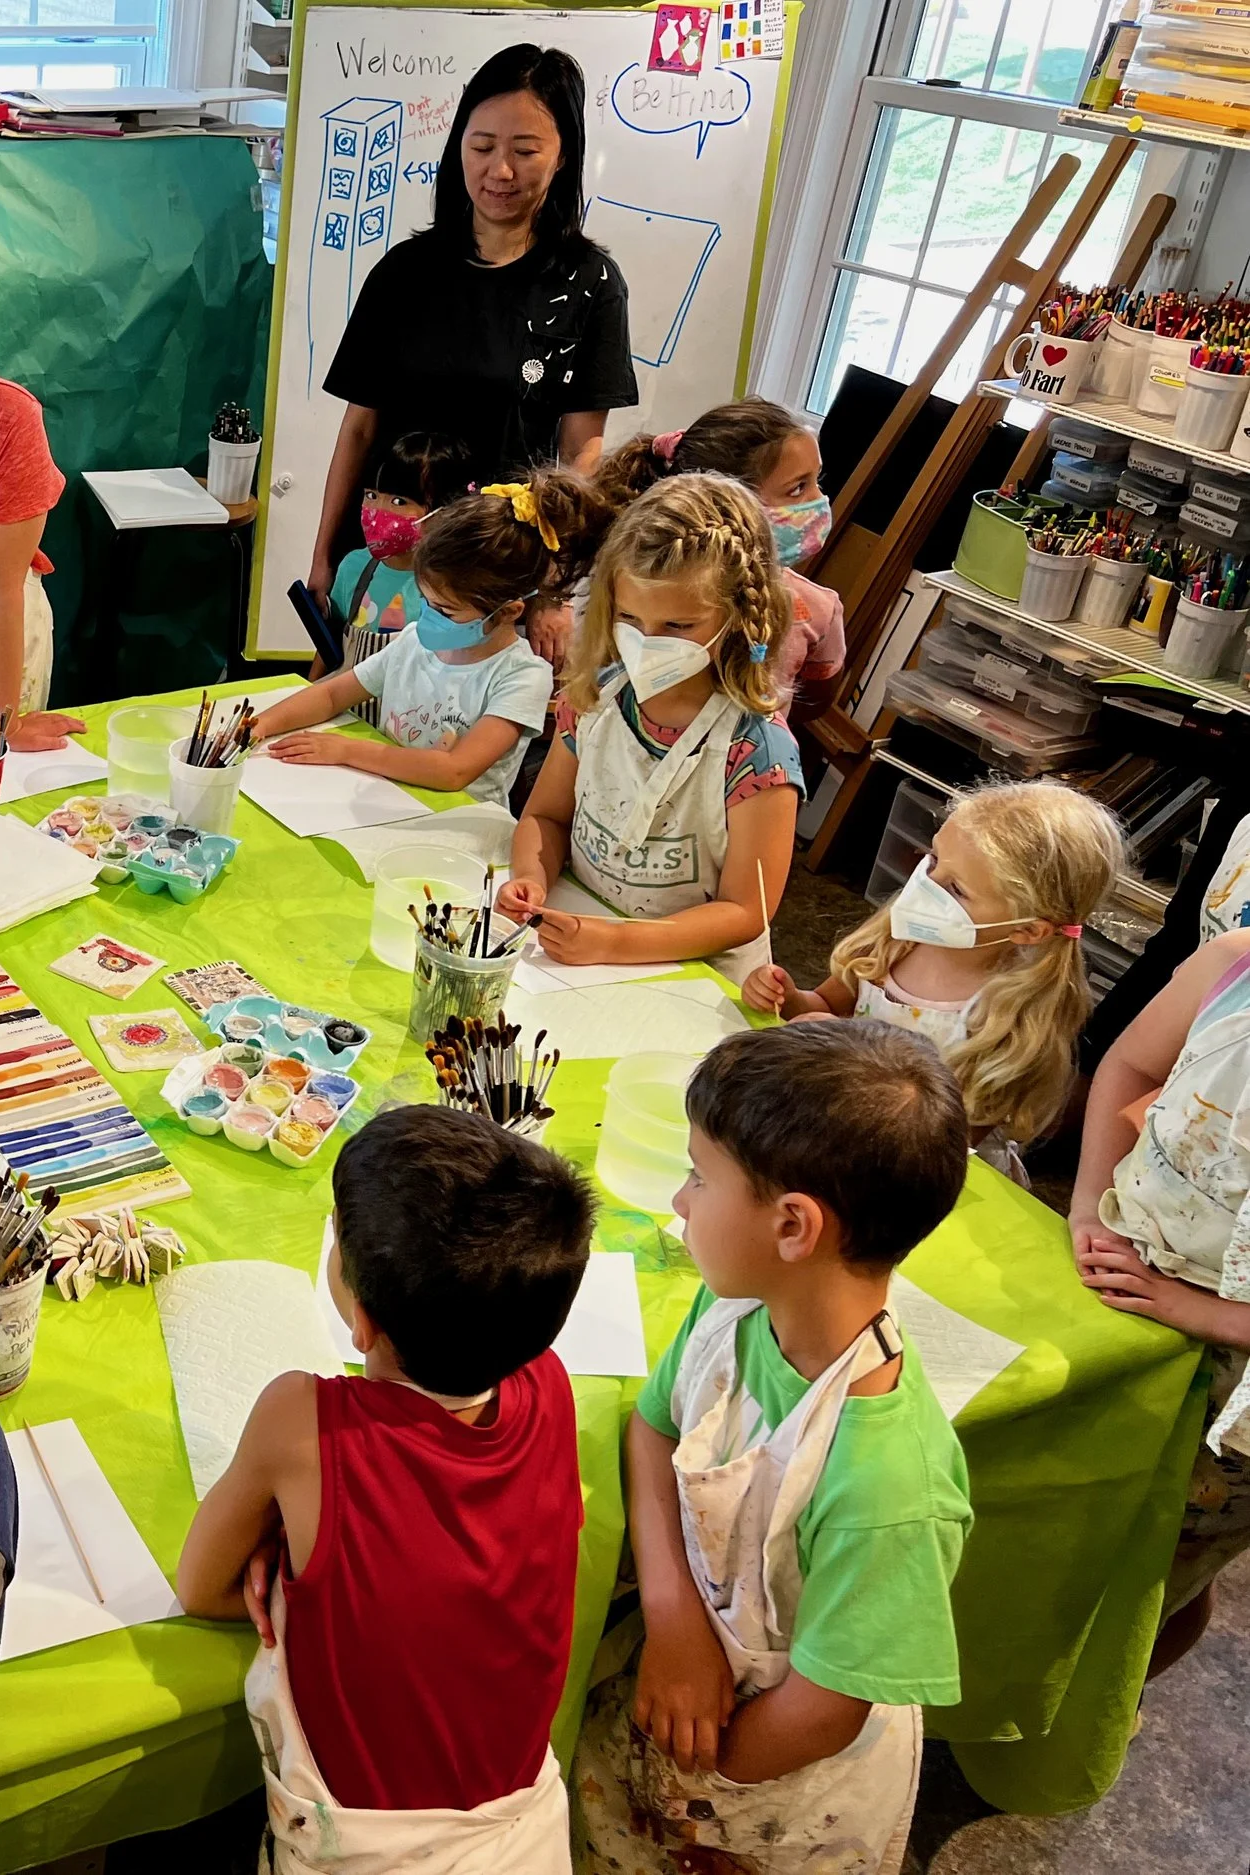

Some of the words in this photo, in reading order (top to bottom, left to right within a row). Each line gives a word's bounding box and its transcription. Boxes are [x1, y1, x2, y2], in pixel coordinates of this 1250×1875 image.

[337, 37, 456, 79] Welcome
[632, 78, 735, 117] Bettina
[1030, 341, 1039, 361] I
[1030, 369, 1066, 396] Fart
